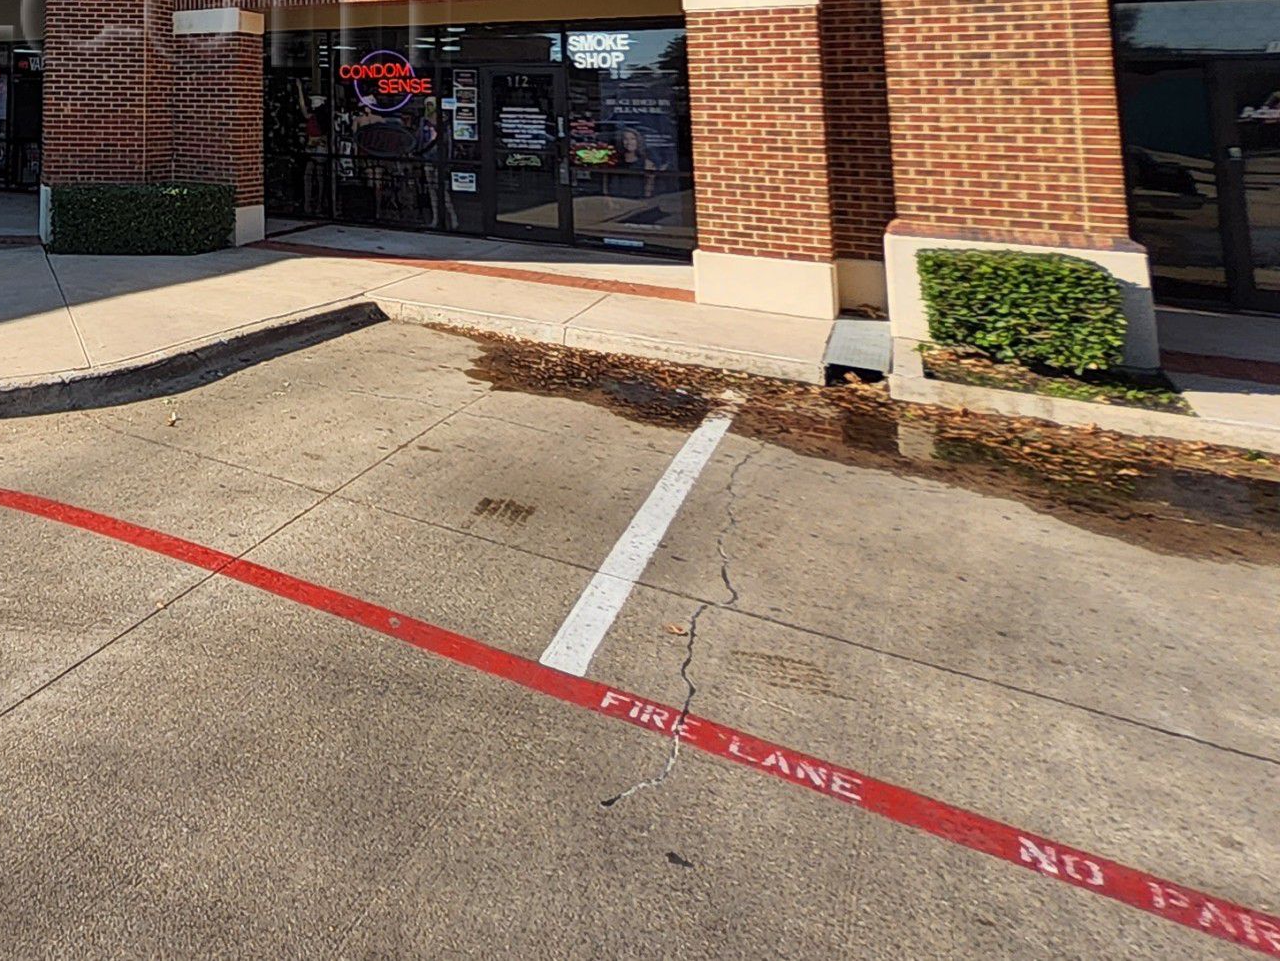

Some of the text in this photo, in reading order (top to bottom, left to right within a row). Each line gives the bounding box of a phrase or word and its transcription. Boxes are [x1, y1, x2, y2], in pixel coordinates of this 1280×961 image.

[568, 33, 631, 51] SMOKE
[573, 52, 625, 69] SHOP
[339, 62, 411, 79] CONDOM
[377, 78, 432, 94] SENSE
[506, 76, 529, 88] 112
[600, 690, 702, 739] FIRE
[728, 735, 863, 801] LANE
[1018, 835, 1105, 886] NO
